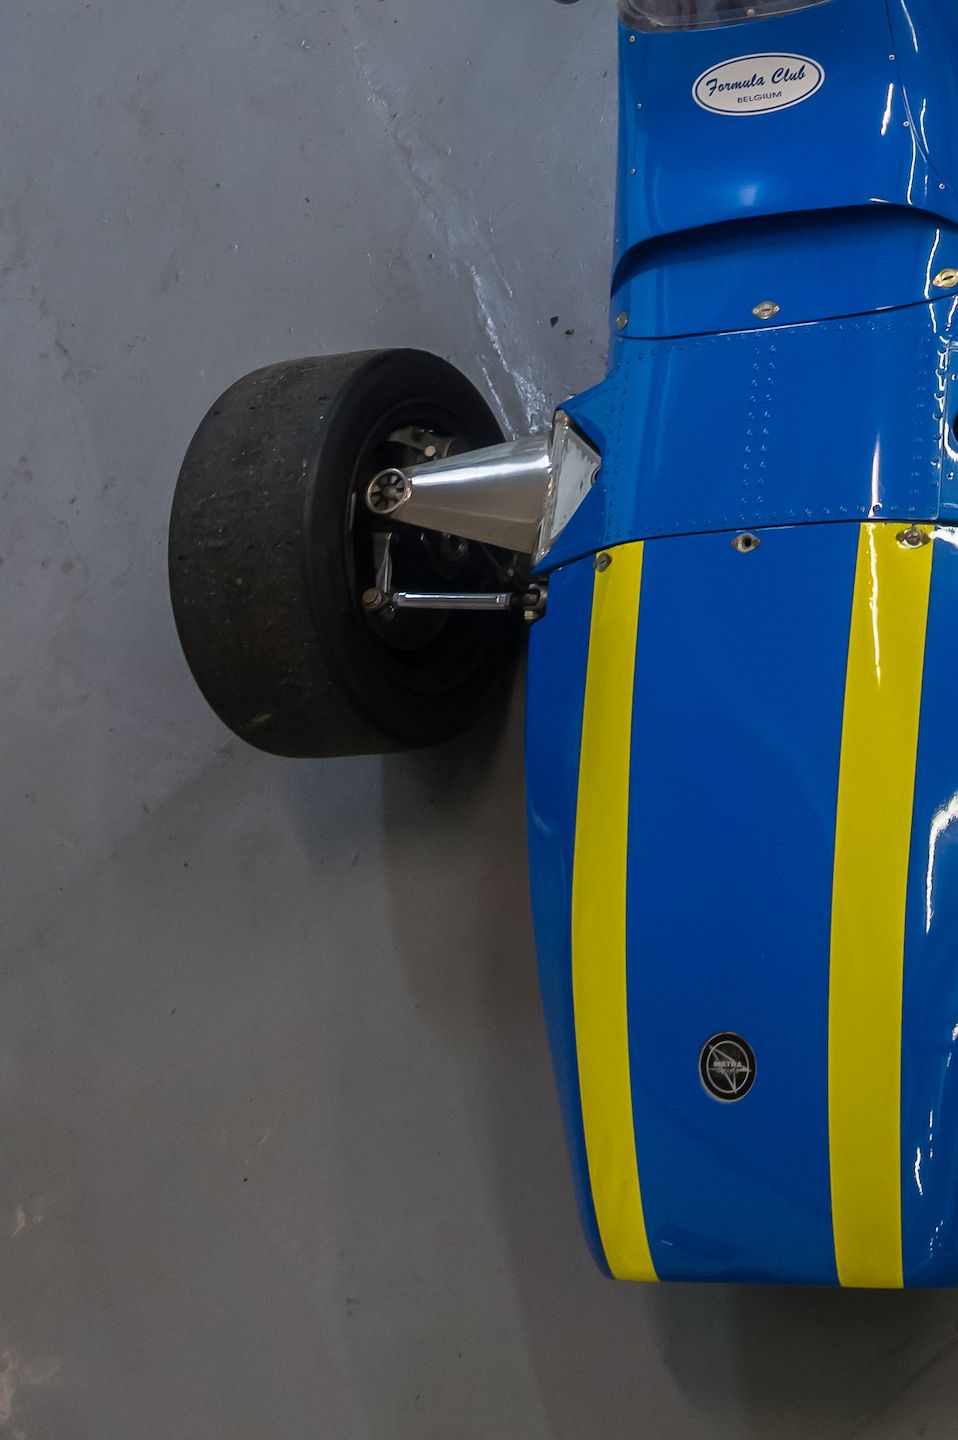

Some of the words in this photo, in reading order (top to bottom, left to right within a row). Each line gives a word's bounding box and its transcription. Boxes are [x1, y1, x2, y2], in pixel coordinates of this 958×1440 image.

[705, 73, 766, 97] Formula
[771, 64, 806, 85] Club
[737, 91, 782, 103] BELGIUM
